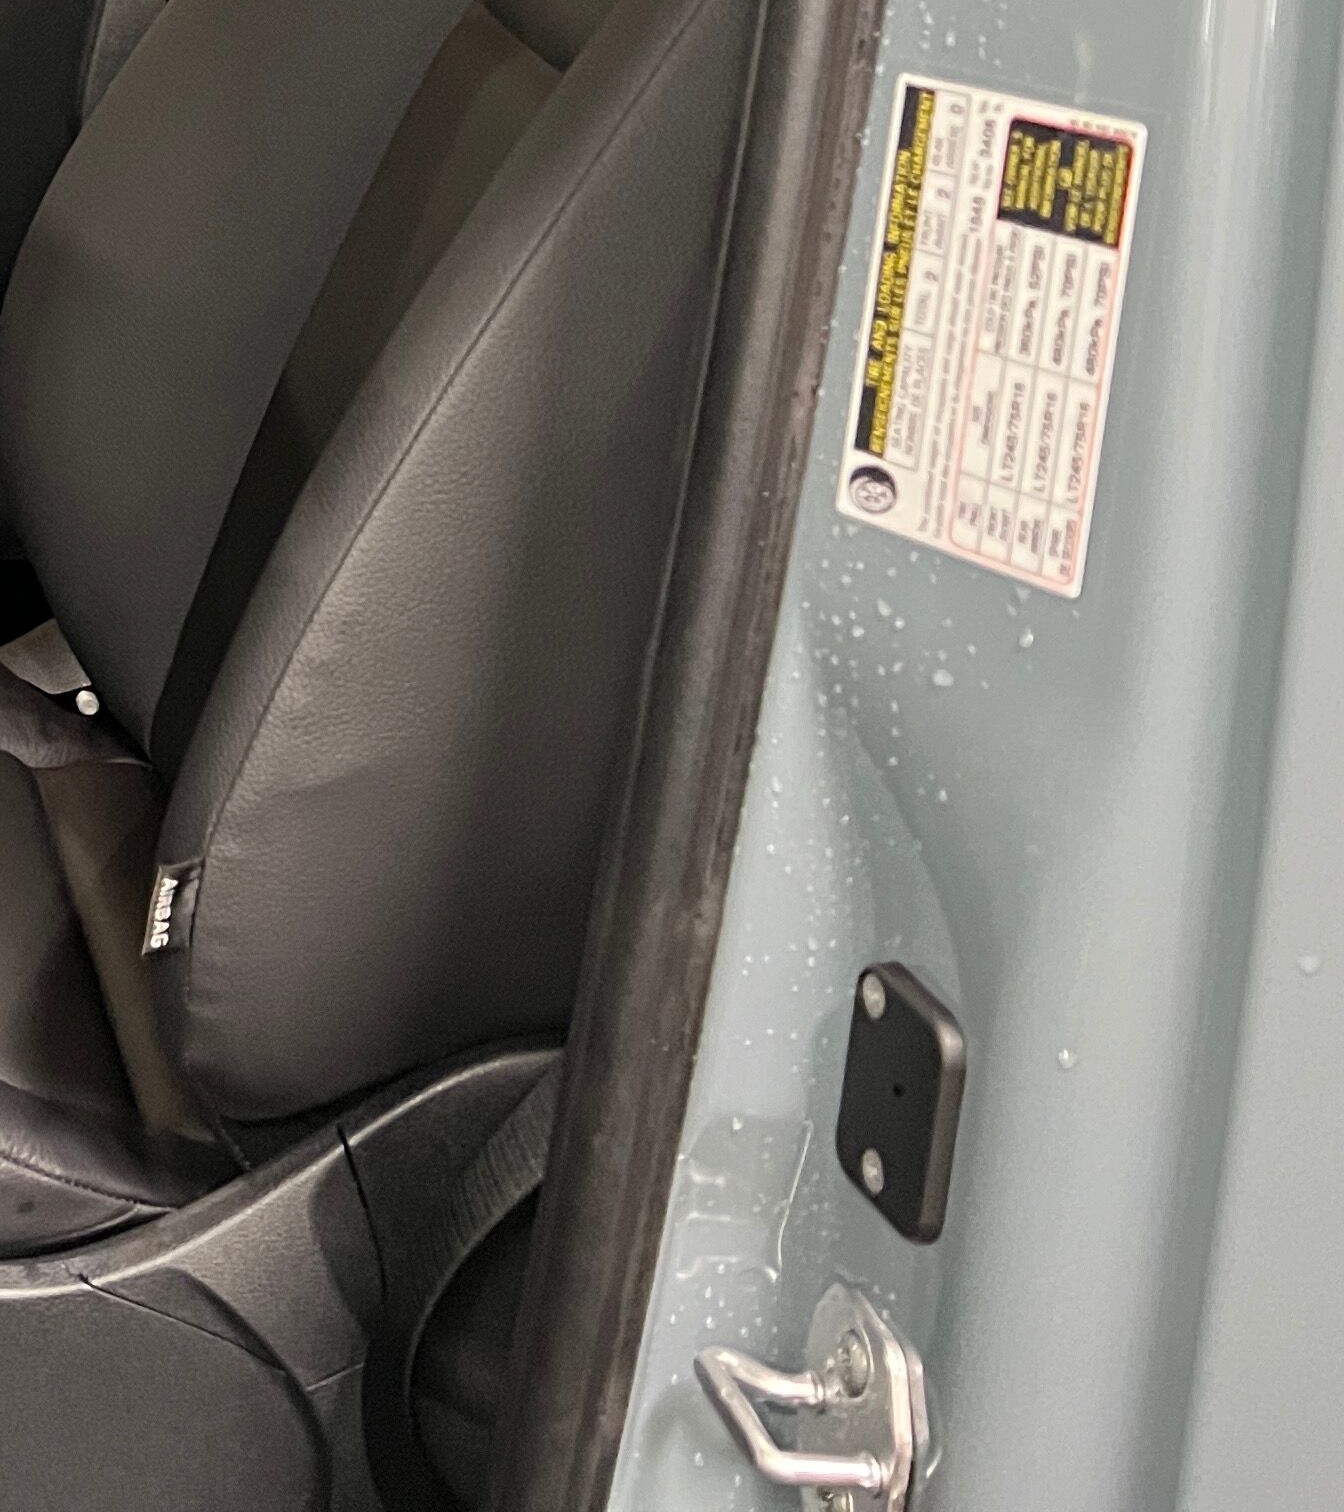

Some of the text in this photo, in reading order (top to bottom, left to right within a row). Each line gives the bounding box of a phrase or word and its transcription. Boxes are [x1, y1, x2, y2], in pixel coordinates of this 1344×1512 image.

[936, 187, 951, 200] 2
[866, 149, 911, 386] TIRE AND LOADING INFORMATION
[870, 91, 934, 456] RENSEIGNEMENTS SUR LES PNEUS ET LE CHARGEMENT
[924, 271, 938, 283] 2
[999, 380, 1026, 482] LT245/75R16
[1032, 390, 1059, 493] LT245/75R16
[1065, 400, 1092, 504] LT245/75R16
[150, 878, 179, 948] AIRBAG
